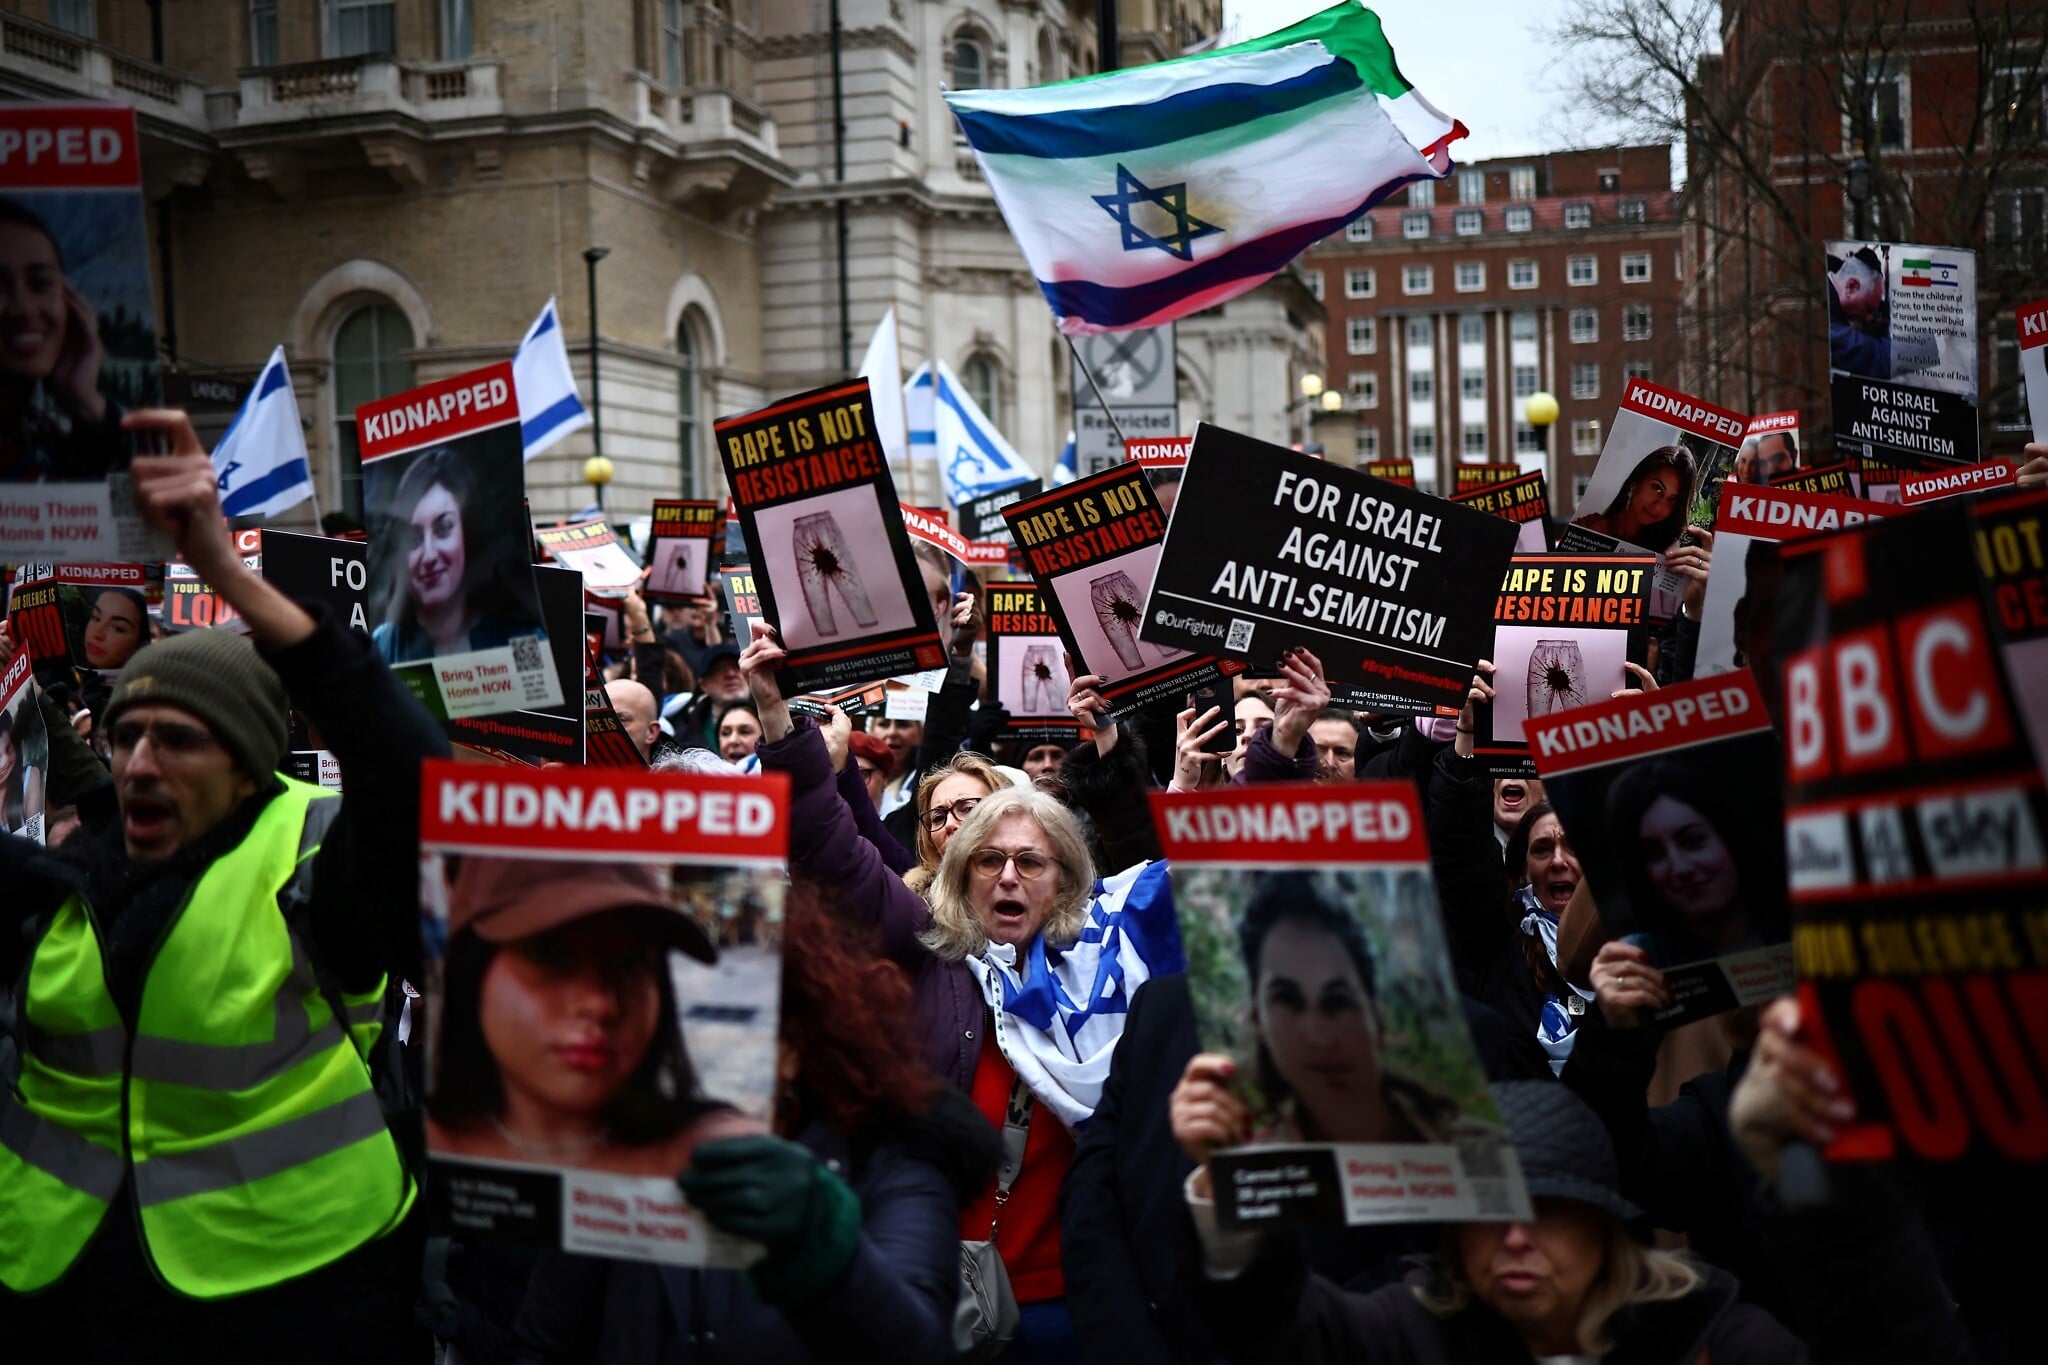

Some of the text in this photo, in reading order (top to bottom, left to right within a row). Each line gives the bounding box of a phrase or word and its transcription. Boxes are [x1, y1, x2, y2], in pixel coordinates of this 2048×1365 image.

[1913, 291, 1925, 300] the
[1926, 292, 1955, 301] children
[1936, 305, 1963, 314] children
[1904, 325, 1927, 333] future
[1934, 315, 1947, 323] will
[1948, 317, 1964, 326] build
[2023, 310, 2048, 337] KI
[1922, 369, 1970, 381] Prince of Iran
[364, 377, 509, 443] KIDNAPPED
[1631, 386, 1743, 437] KIDNAPPED
[1862, 384, 1940, 414] FOR ISRAEL
[1871, 406, 1931, 431] AGAINST
[728, 402, 867, 469] RAPE IS NOT
[1852, 421, 1955, 456] ANTI-SEMITISM
[735, 440, 881, 506] RESISTANCE!
[1805, 471, 1846, 493] IS NOT
[1906, 465, 2008, 497] KIDNAPPED
[1274, 470, 1443, 553] FOR ISRAEL
[1467, 481, 1540, 512] APE IS NOT
[1017, 505, 1074, 546] RAPE
[1074, 497, 1100, 527] IS
[1101, 479, 1148, 517] NOT
[1729, 495, 1888, 531] KIDNAP
[1029, 508, 1166, 576] RESISTANCE!
[60, 565, 140, 580] KIDNAPPED
[331, 557, 367, 591] FO
[1277, 526, 1419, 592] AGAINST
[173, 583, 200, 594] YOUR
[1562, 568, 1588, 593] IS
[1596, 568, 1645, 594] NOT
[22, 587, 56, 607] SILENCE IS
[734, 596, 761, 614] RE
[994, 593, 1034, 612] RAPE
[1211, 560, 1447, 648] ANTI-SEMITISM
[442, 664, 508, 683] Bring Them
[1136, 664, 1216, 699] #RAPEISNOTRESISTANCE
[1361, 658, 1464, 692] #BringThemHomeNow
[447, 687, 479, 699] Home
[1788, 615, 1990, 770] BBC
[455, 717, 574, 747] #BringThemHomeNow
[604, 718, 618, 732] IS
[1536, 686, 1750, 757] KIDNAPPED
[438, 780, 775, 837] KIDNAPPED
[1166, 800, 1410, 842] KIDNAPPED
